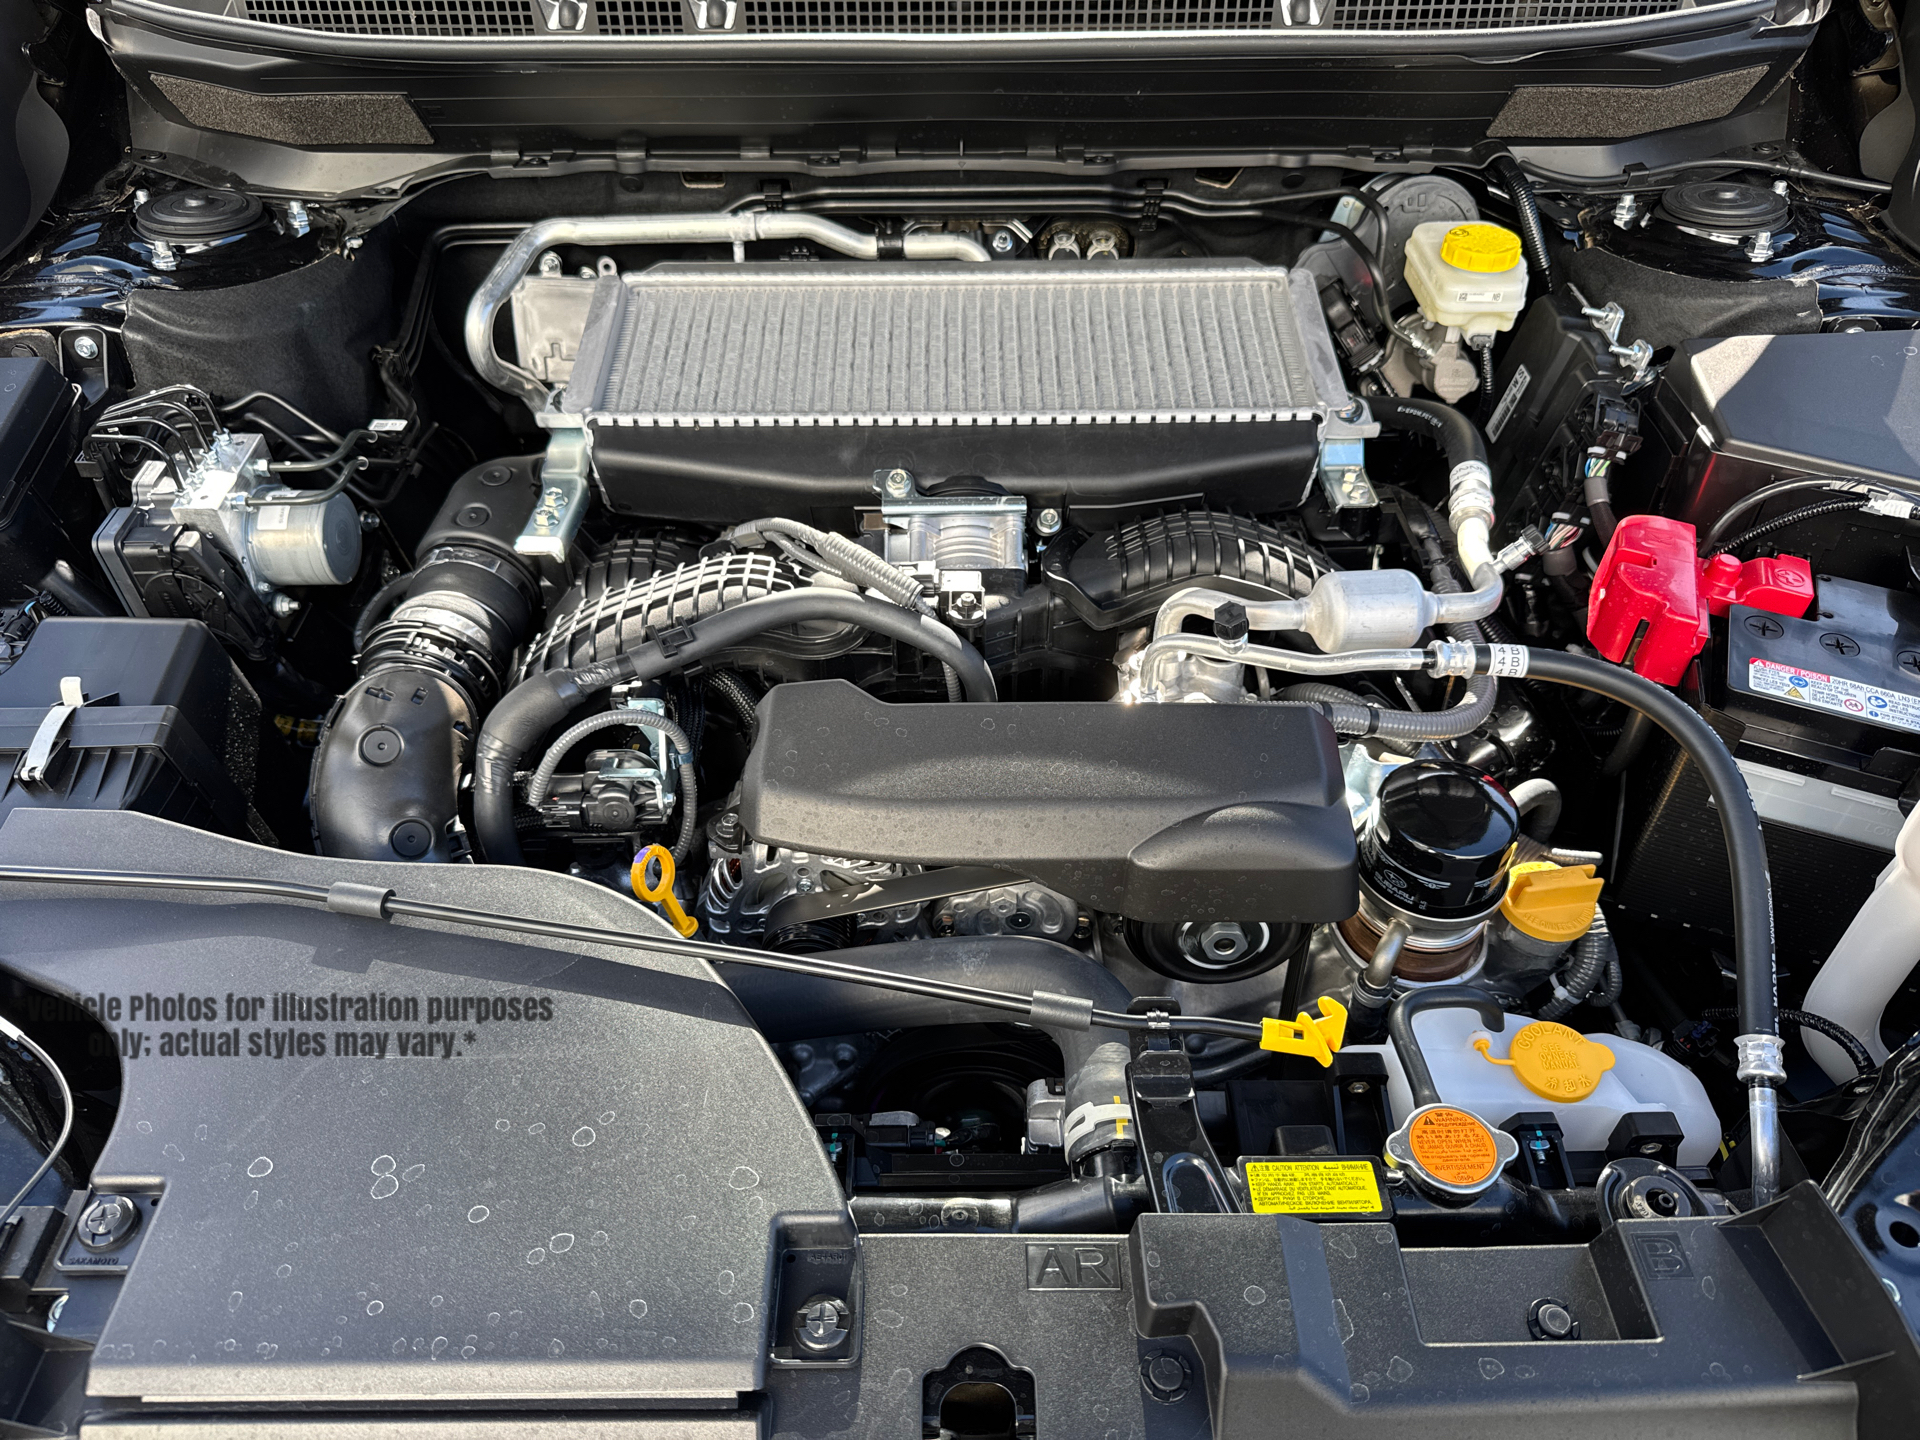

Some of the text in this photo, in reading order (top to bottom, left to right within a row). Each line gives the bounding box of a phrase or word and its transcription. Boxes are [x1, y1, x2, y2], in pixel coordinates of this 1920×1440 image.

[1766, 662, 1796, 675] DANGER
[1800, 671, 1828, 682] POISON
[1832, 678, 1848, 687] 20HR
[1866, 686, 1880, 694] CCA
[1374, 871, 1415, 900] SUBARU
[1524, 913, 1538, 924] SEE
[1516, 1024, 1586, 1049] COOLANT
[1540, 1050, 1576, 1060] OWNERS
[1542, 1044, 1561, 1052] SEE
[1542, 1060, 1580, 1070] MANUAL
[1638, 1237, 1686, 1274] B
[1036, 1247, 1114, 1286] AR
